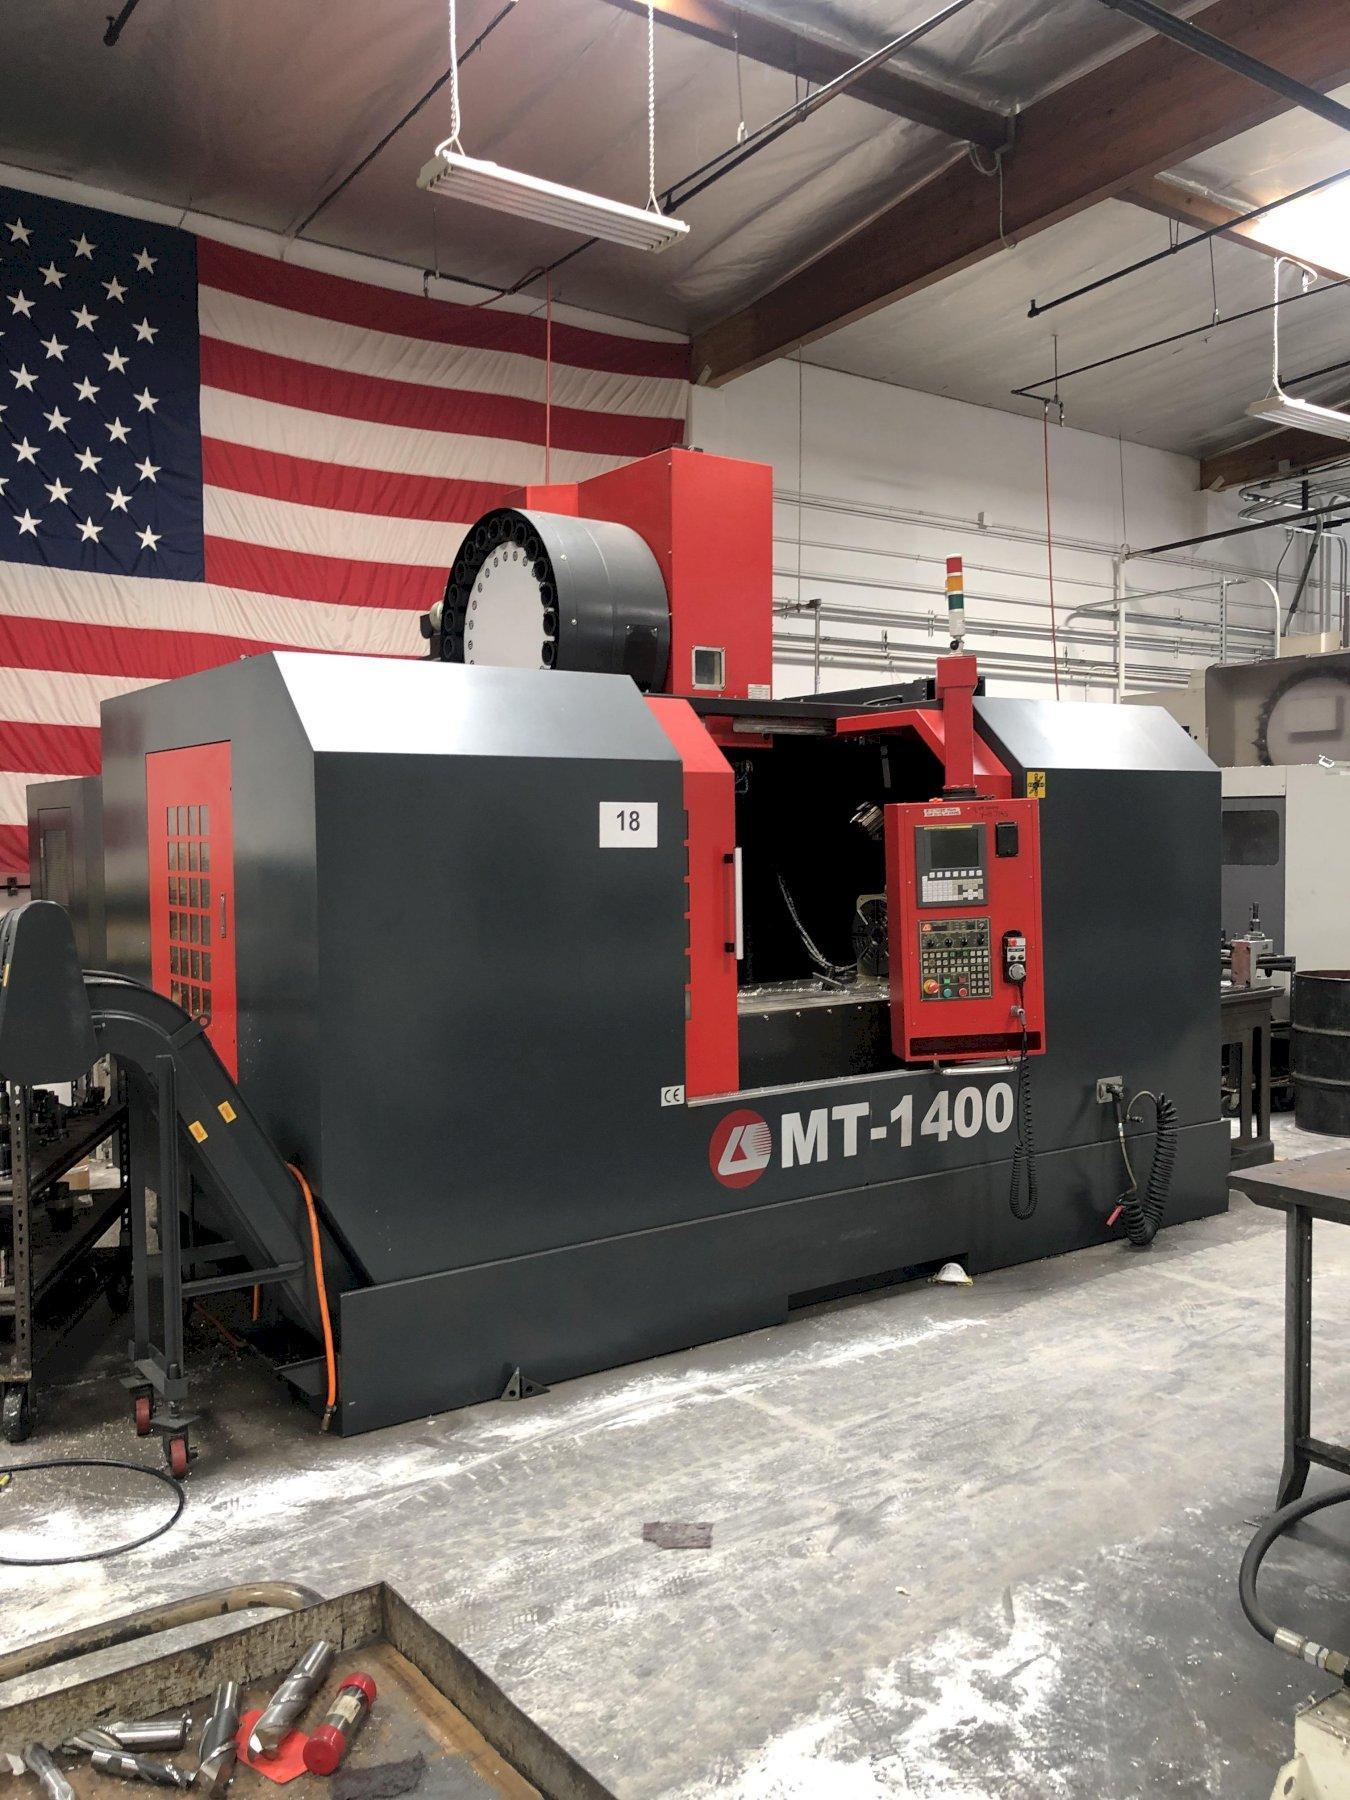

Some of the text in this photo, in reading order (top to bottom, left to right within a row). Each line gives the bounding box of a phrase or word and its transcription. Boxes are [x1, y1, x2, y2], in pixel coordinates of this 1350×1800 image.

[616, 810, 641, 832] 18
[664, 1087, 680, 1103] CE
[781, 1082, 1014, 1169] MT-1400
